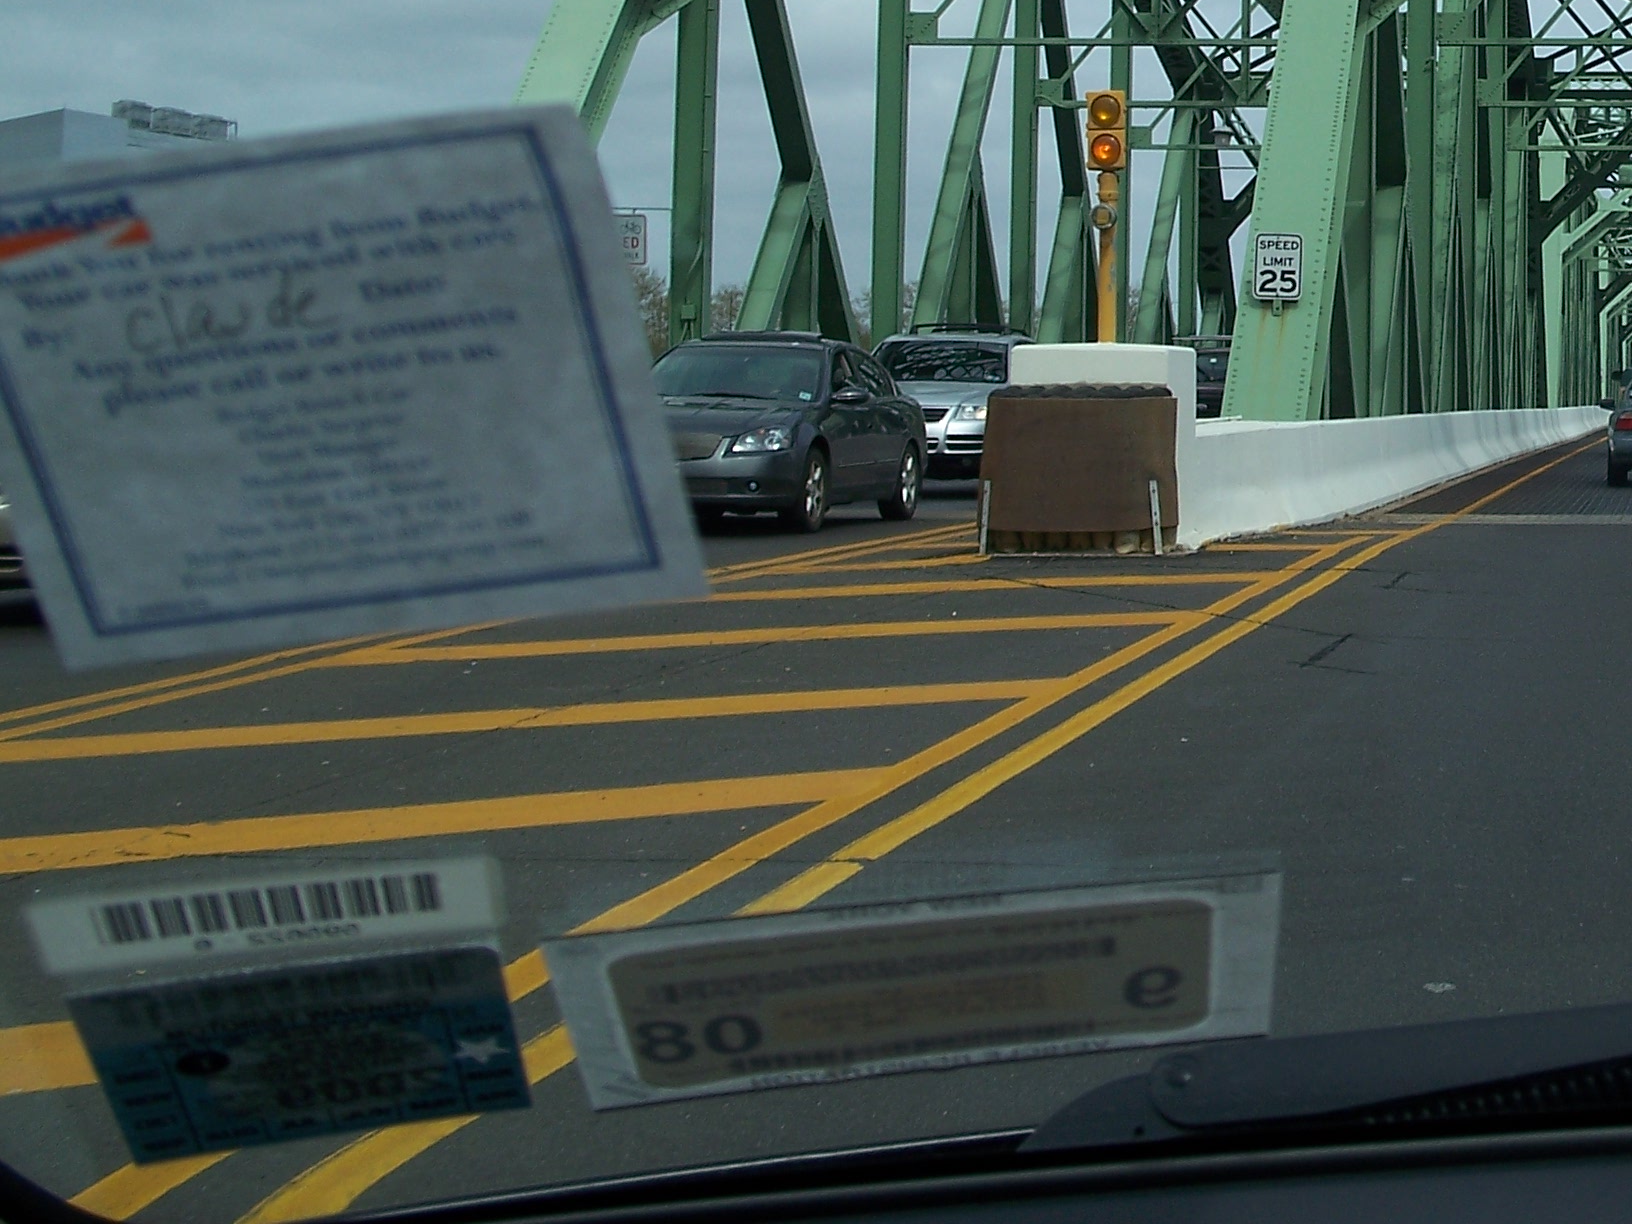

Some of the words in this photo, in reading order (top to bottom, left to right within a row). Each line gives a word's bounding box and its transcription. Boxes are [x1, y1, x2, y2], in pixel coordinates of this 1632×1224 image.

[1260, 240, 1299, 250] SPEED
[1263, 257, 1294, 266] LIMIT
[1259, 269, 1297, 292] 25
